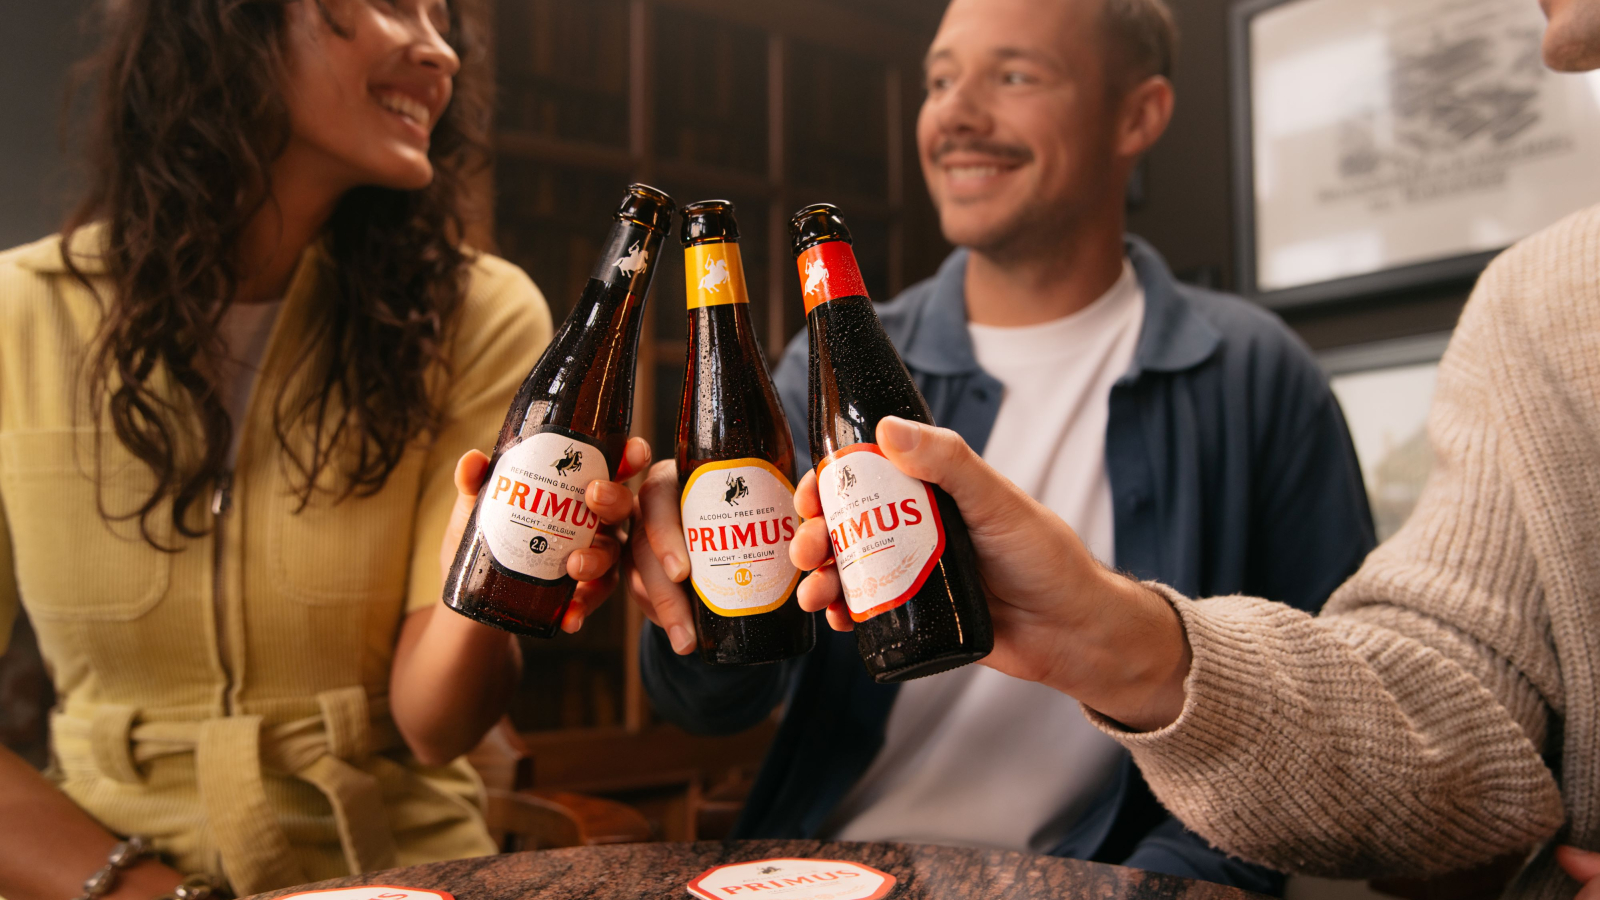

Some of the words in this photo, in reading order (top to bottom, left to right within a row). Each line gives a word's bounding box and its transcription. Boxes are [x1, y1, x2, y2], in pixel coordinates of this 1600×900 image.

[510, 466, 558, 487] REFRESHING
[560, 482, 585, 495] BLOND
[491, 475, 598, 530] PRIMUS
[861, 492, 880, 504] PILS
[511, 512, 540, 526] HAACHT
[547, 523, 576, 536] BELGIUM
[699, 512, 732, 521] ALCOHOL
[734, 508, 754, 517] FREE
[756, 507, 775, 515] BEER
[687, 516, 795, 552] PRIMUS
[830, 498, 922, 557] RIMUS
[531, 537, 547, 552] 2.6
[861, 536, 895, 553] BELGIUM
[709, 554, 735, 563] HAACHT
[743, 550, 775, 561] BELGIUM
[736, 571, 751, 583] 0.4
[720, 869, 861, 895] PRIMUS
